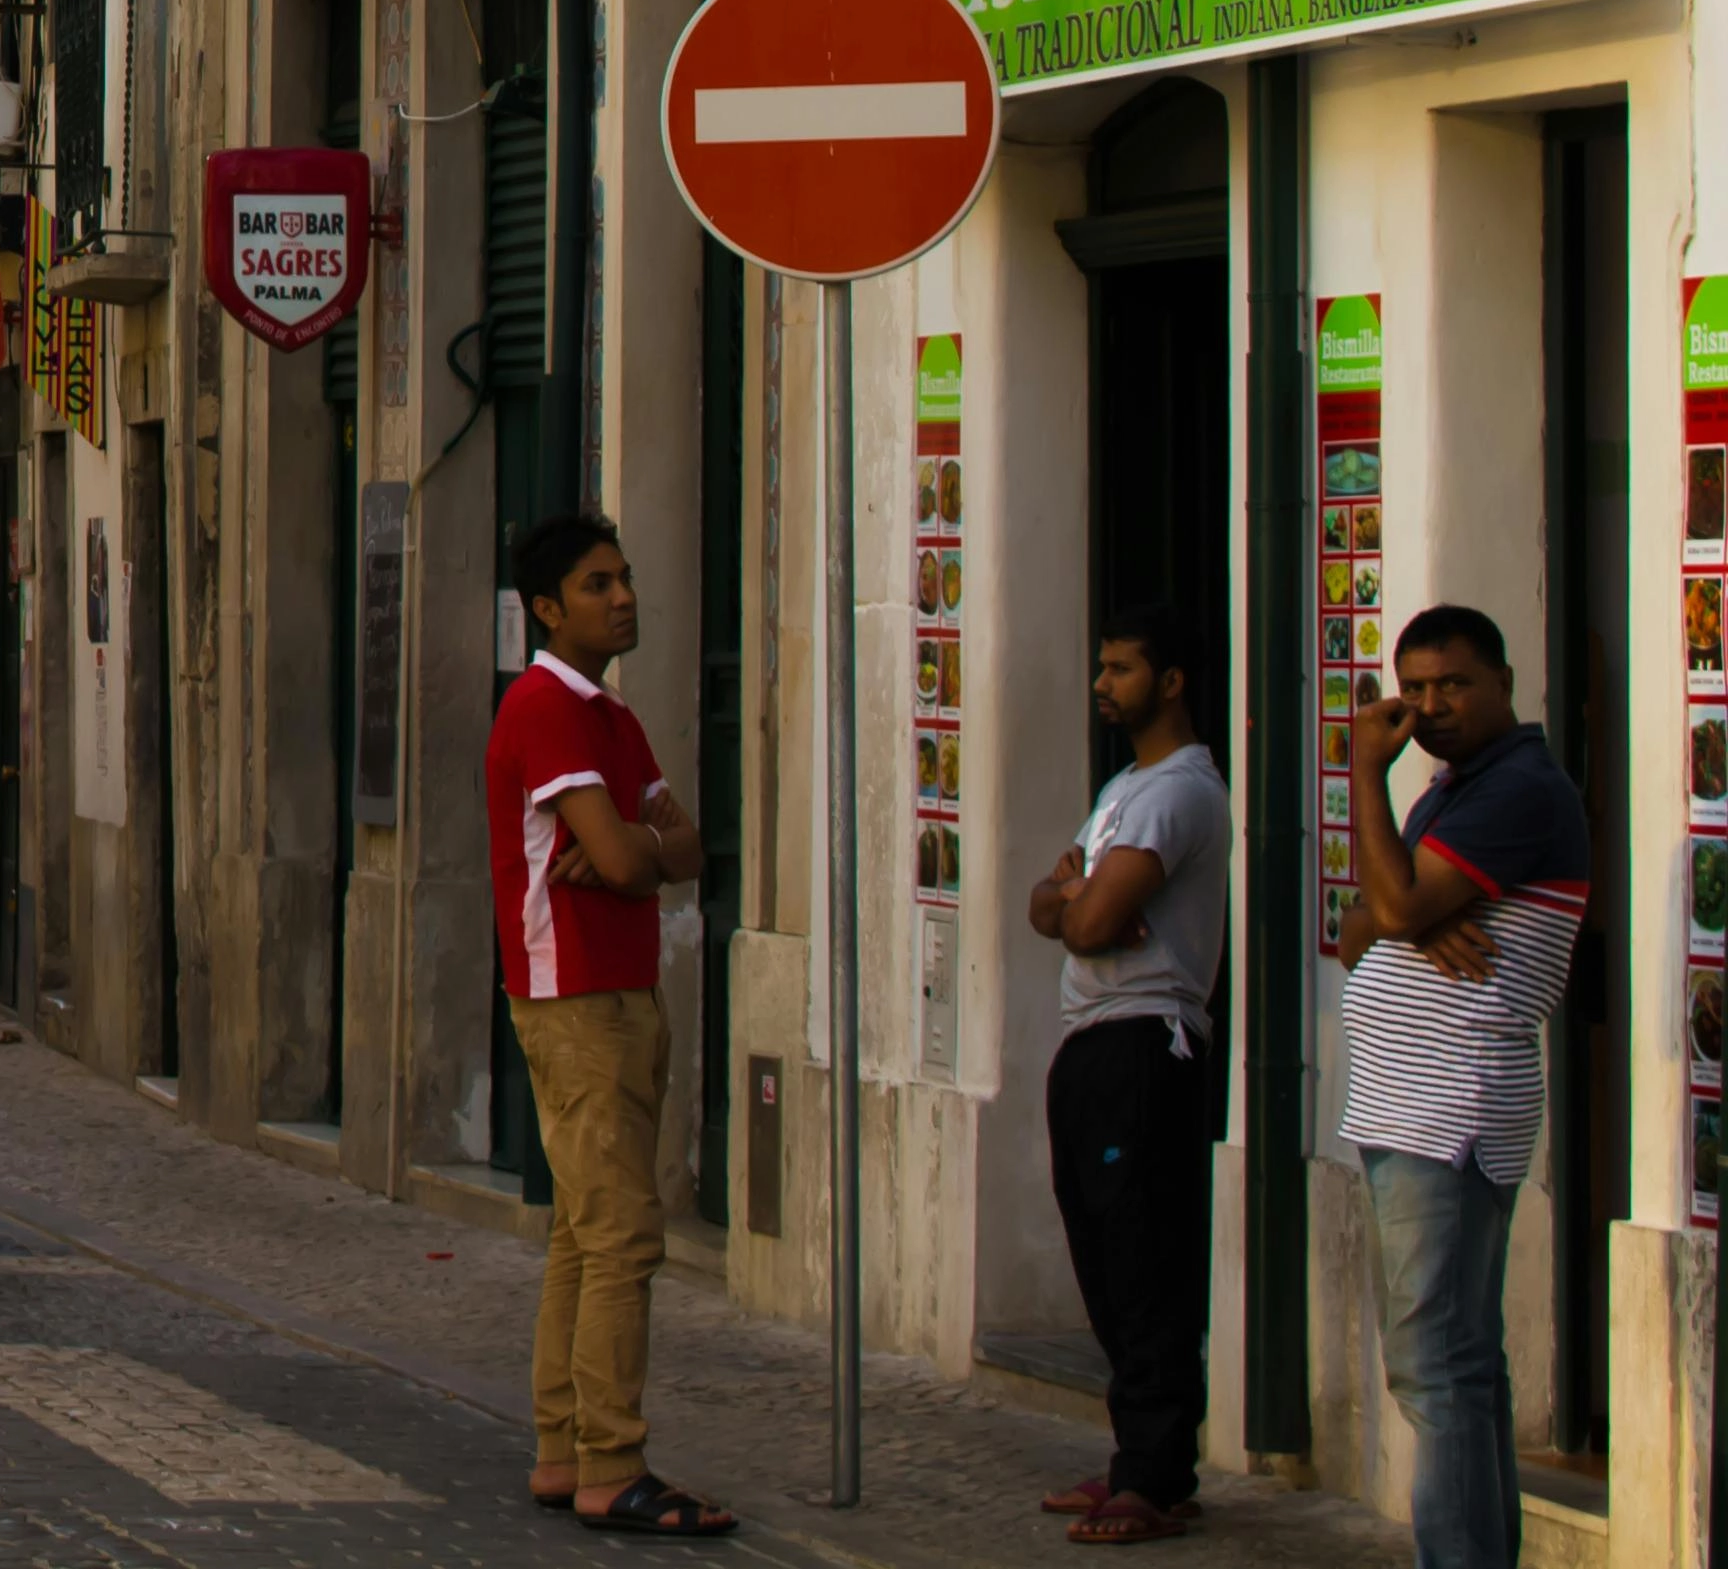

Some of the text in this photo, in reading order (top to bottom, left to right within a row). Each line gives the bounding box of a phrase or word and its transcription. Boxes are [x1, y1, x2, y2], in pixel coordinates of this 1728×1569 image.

[239, 212, 344, 235] BAR BAR
[241, 248, 343, 277] SAGRES
[254, 285, 322, 301] PALMA
